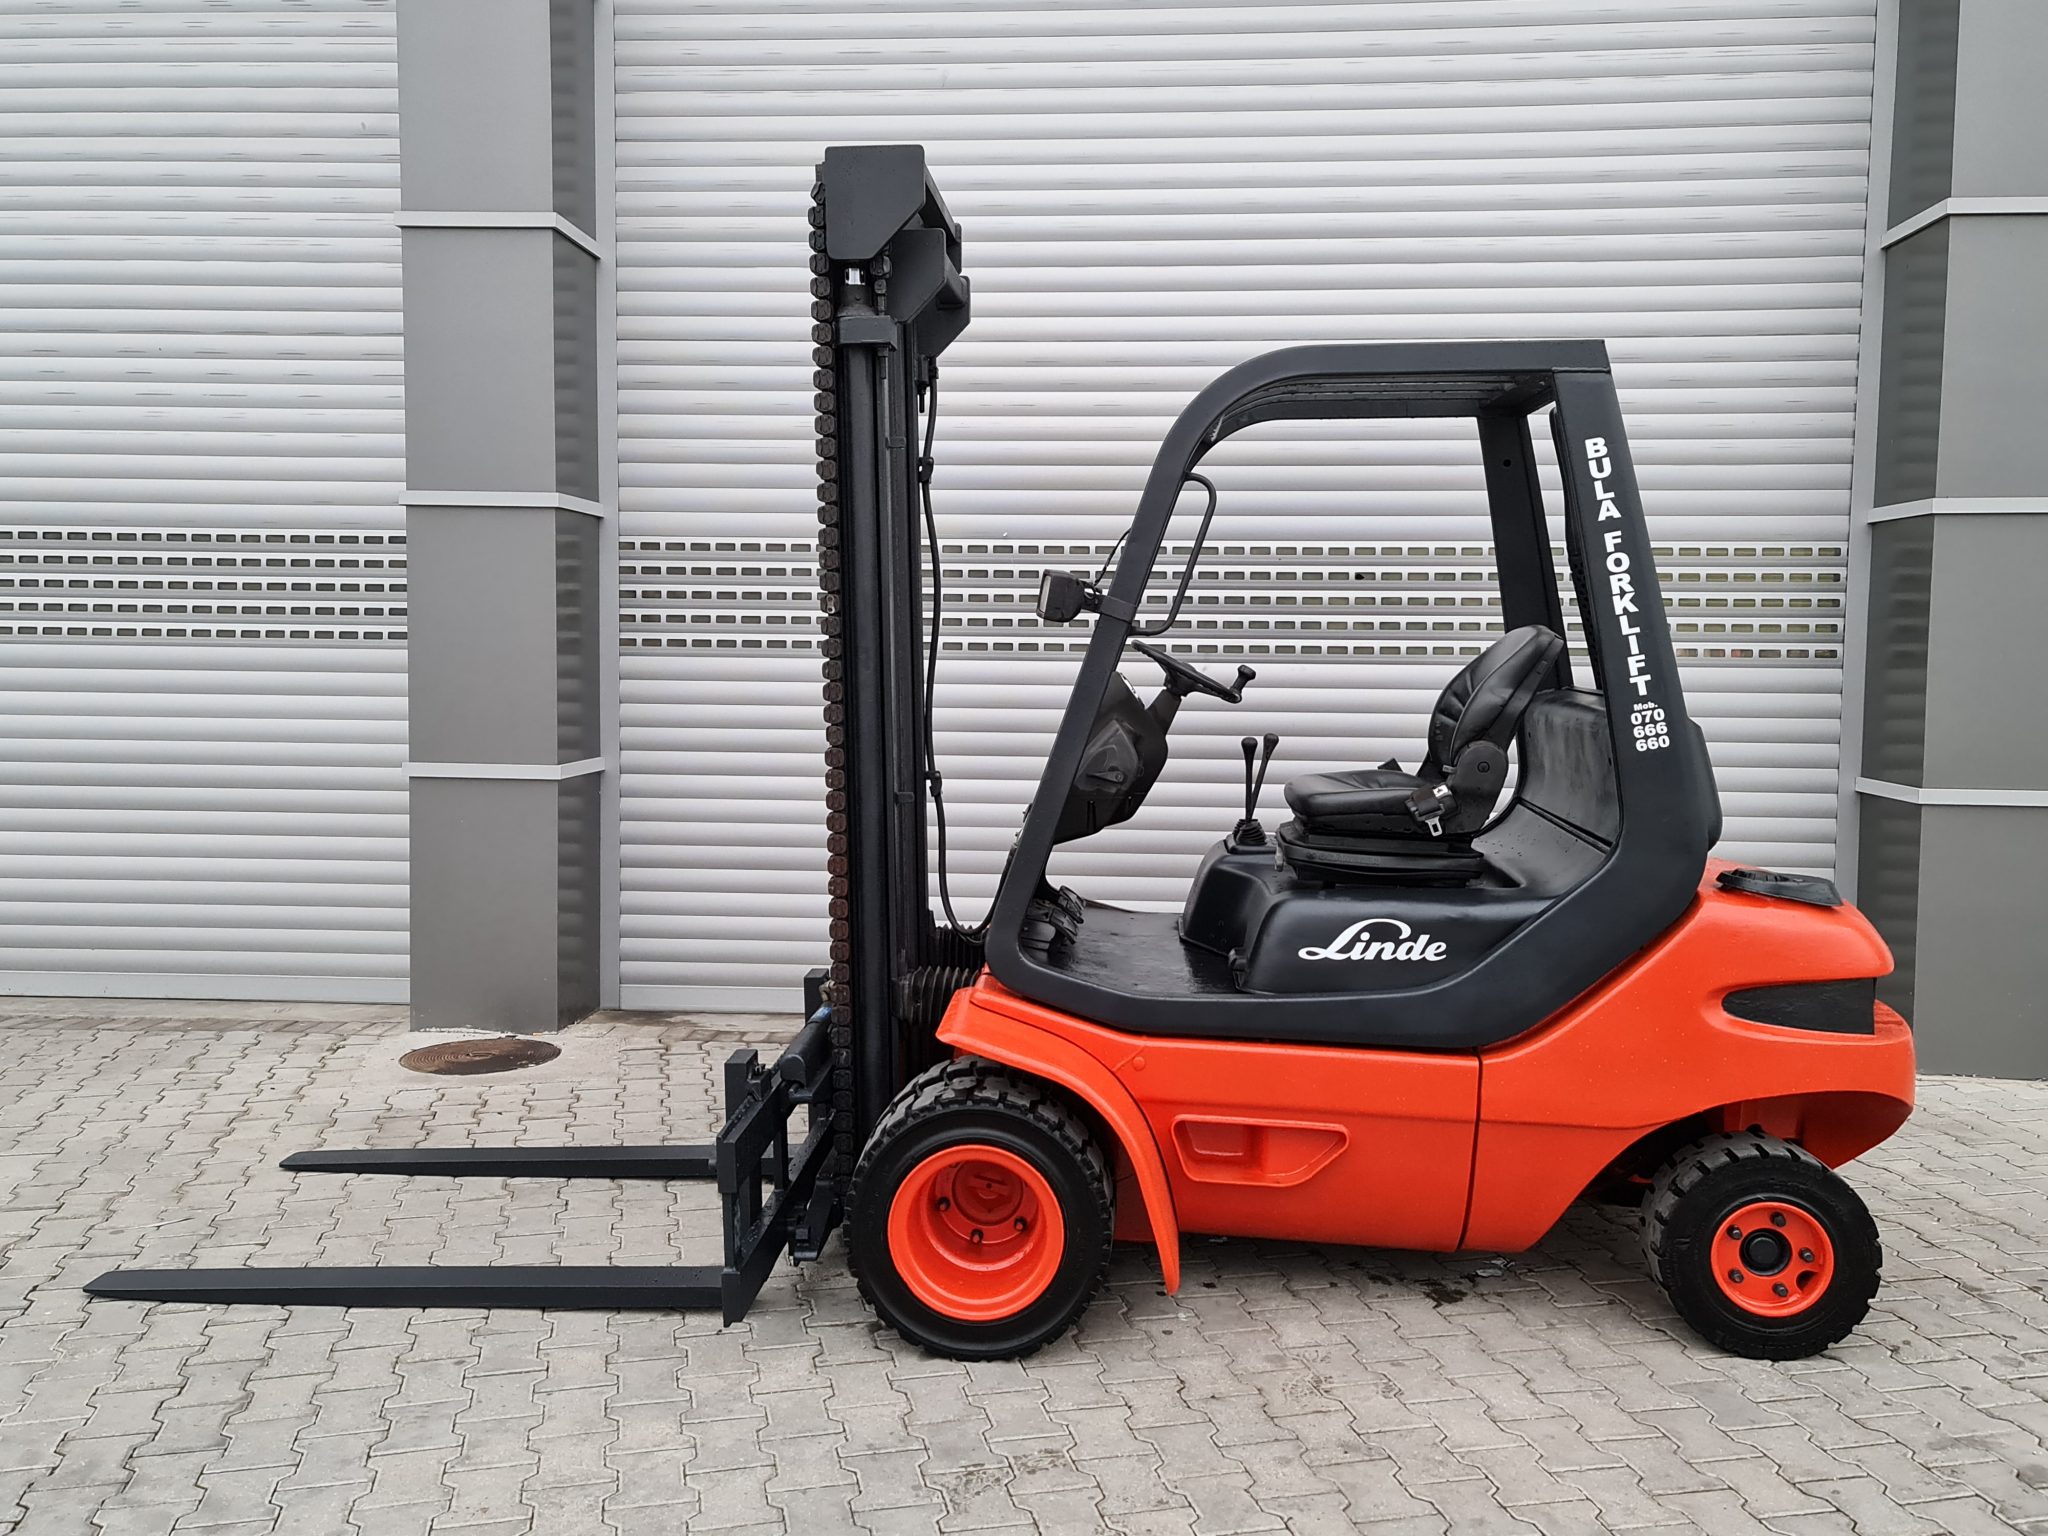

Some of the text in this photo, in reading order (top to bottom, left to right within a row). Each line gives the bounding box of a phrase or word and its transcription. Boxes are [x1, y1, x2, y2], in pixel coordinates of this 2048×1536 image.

[1585, 437, 1651, 696] BULA FORKLIFT
[1633, 701, 1658, 710] Mob.
[1631, 708, 1665, 725] 070
[1633, 722, 1668, 738] 666
[1635, 735, 1670, 751] 660
[1298, 918, 1447, 961] Linde
